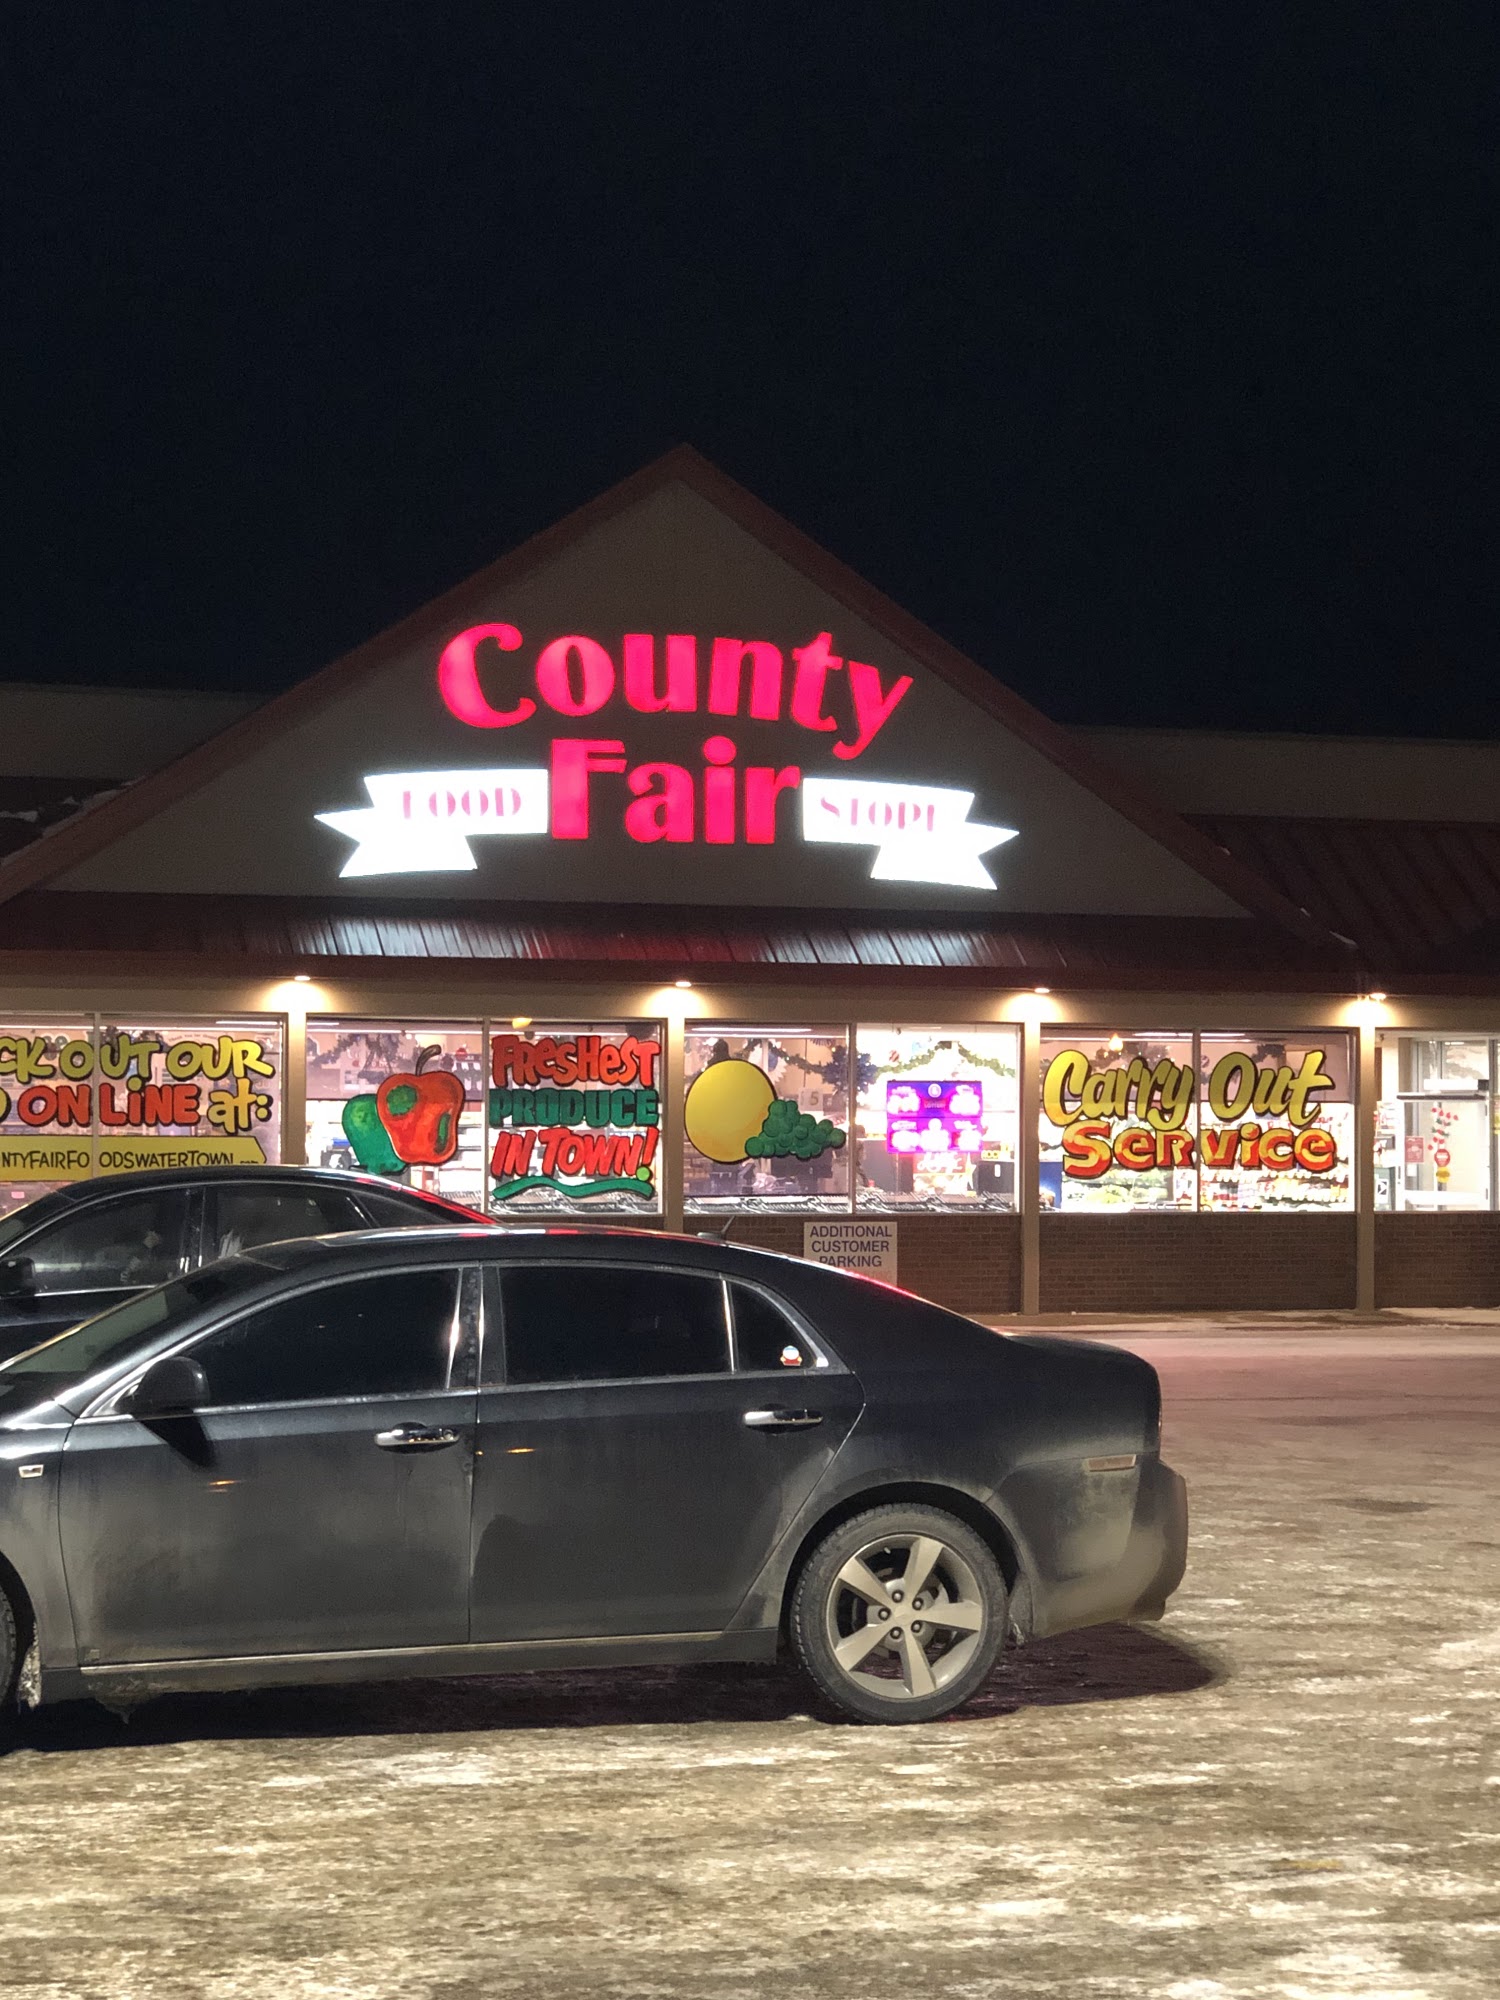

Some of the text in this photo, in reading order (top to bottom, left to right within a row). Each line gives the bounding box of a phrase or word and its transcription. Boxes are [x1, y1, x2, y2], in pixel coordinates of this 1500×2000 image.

[438, 622, 914, 760] County
[550, 736, 802, 845] Fair
[59, 1034, 163, 1081] OUT
[165, 1035, 276, 1081] OUR
[17, 1084, 93, 1127] ON
[488, 1088, 660, 1127] PRODUCE
[1043, 1049, 1334, 1130] Carry Out
[491, 1126, 661, 1182] IN TOWN!
[810, 1225, 892, 1237] ADDITIONAL
[811, 1240, 890, 1252] CUSTOMER
[819, 1255, 882, 1267] PARKING
